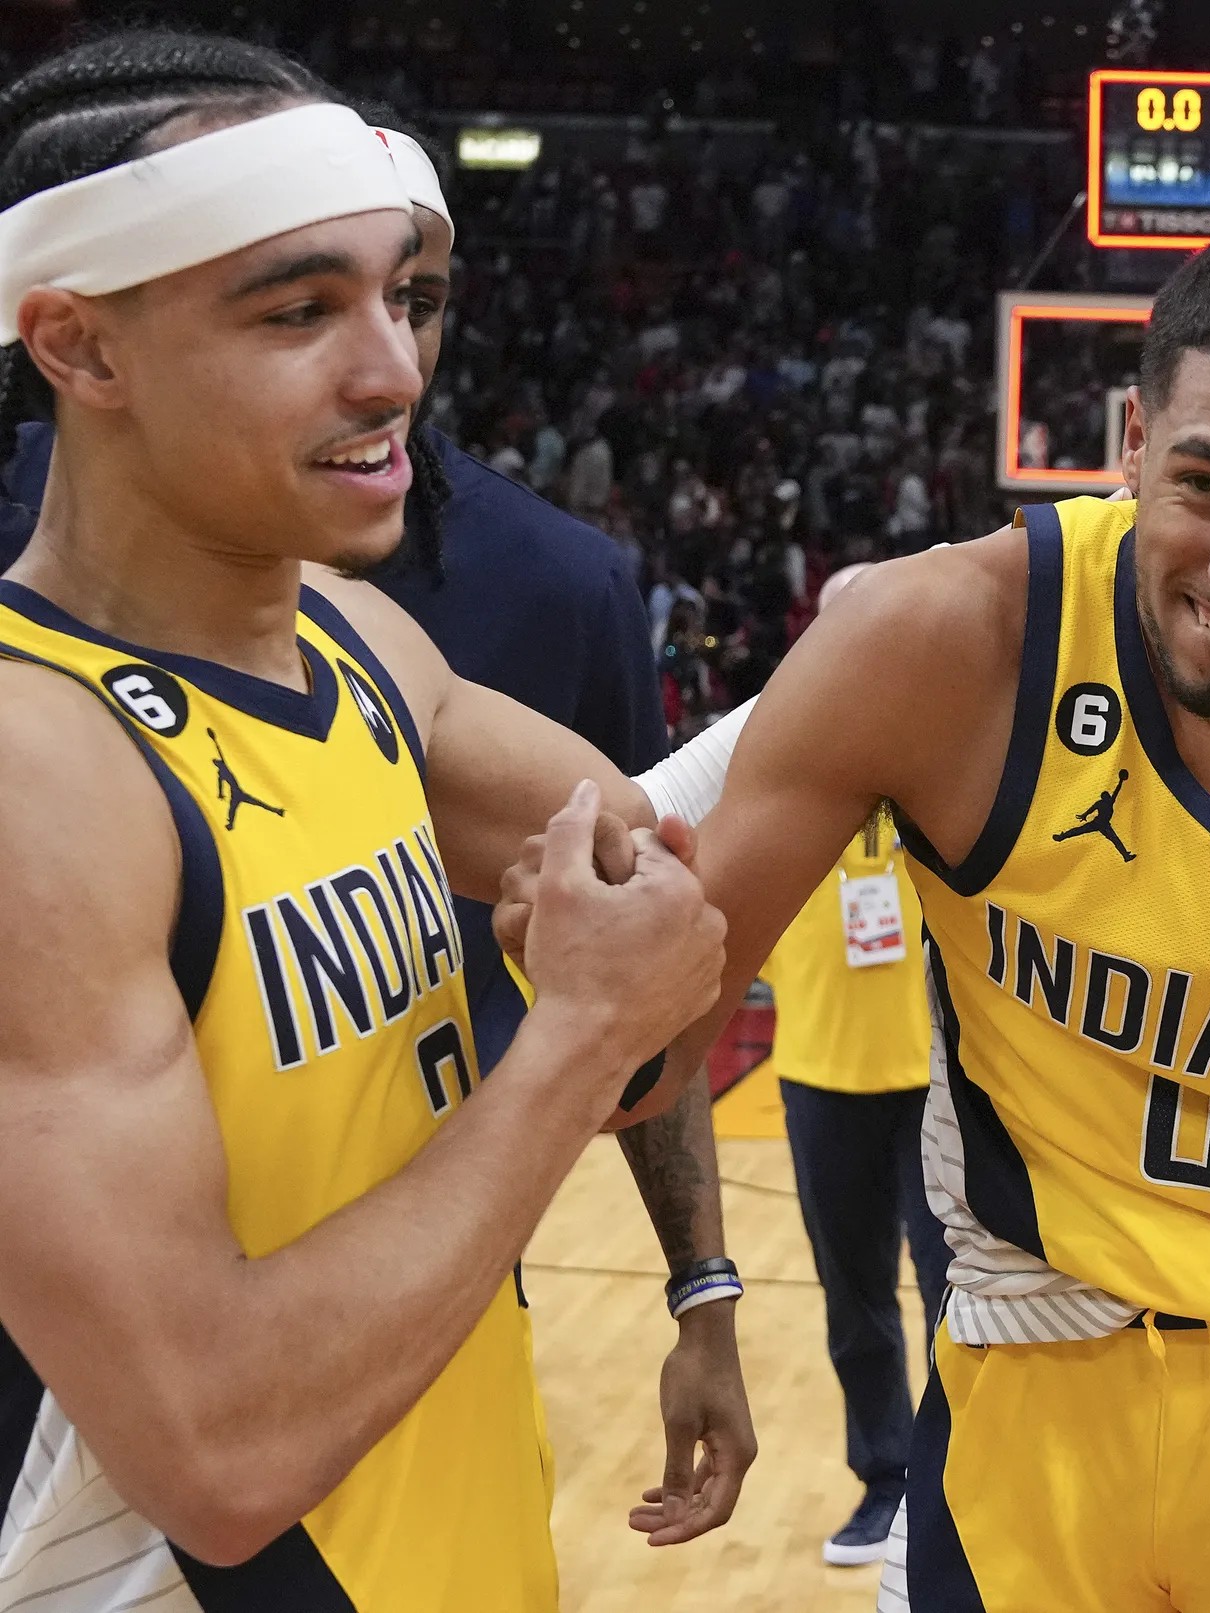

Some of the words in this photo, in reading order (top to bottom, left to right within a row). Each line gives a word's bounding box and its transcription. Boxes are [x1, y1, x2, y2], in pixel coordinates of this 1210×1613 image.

[1137, 88, 1201, 131] 0.0
[112, 673, 177, 732] 6
[1071, 693, 1109, 746] 6
